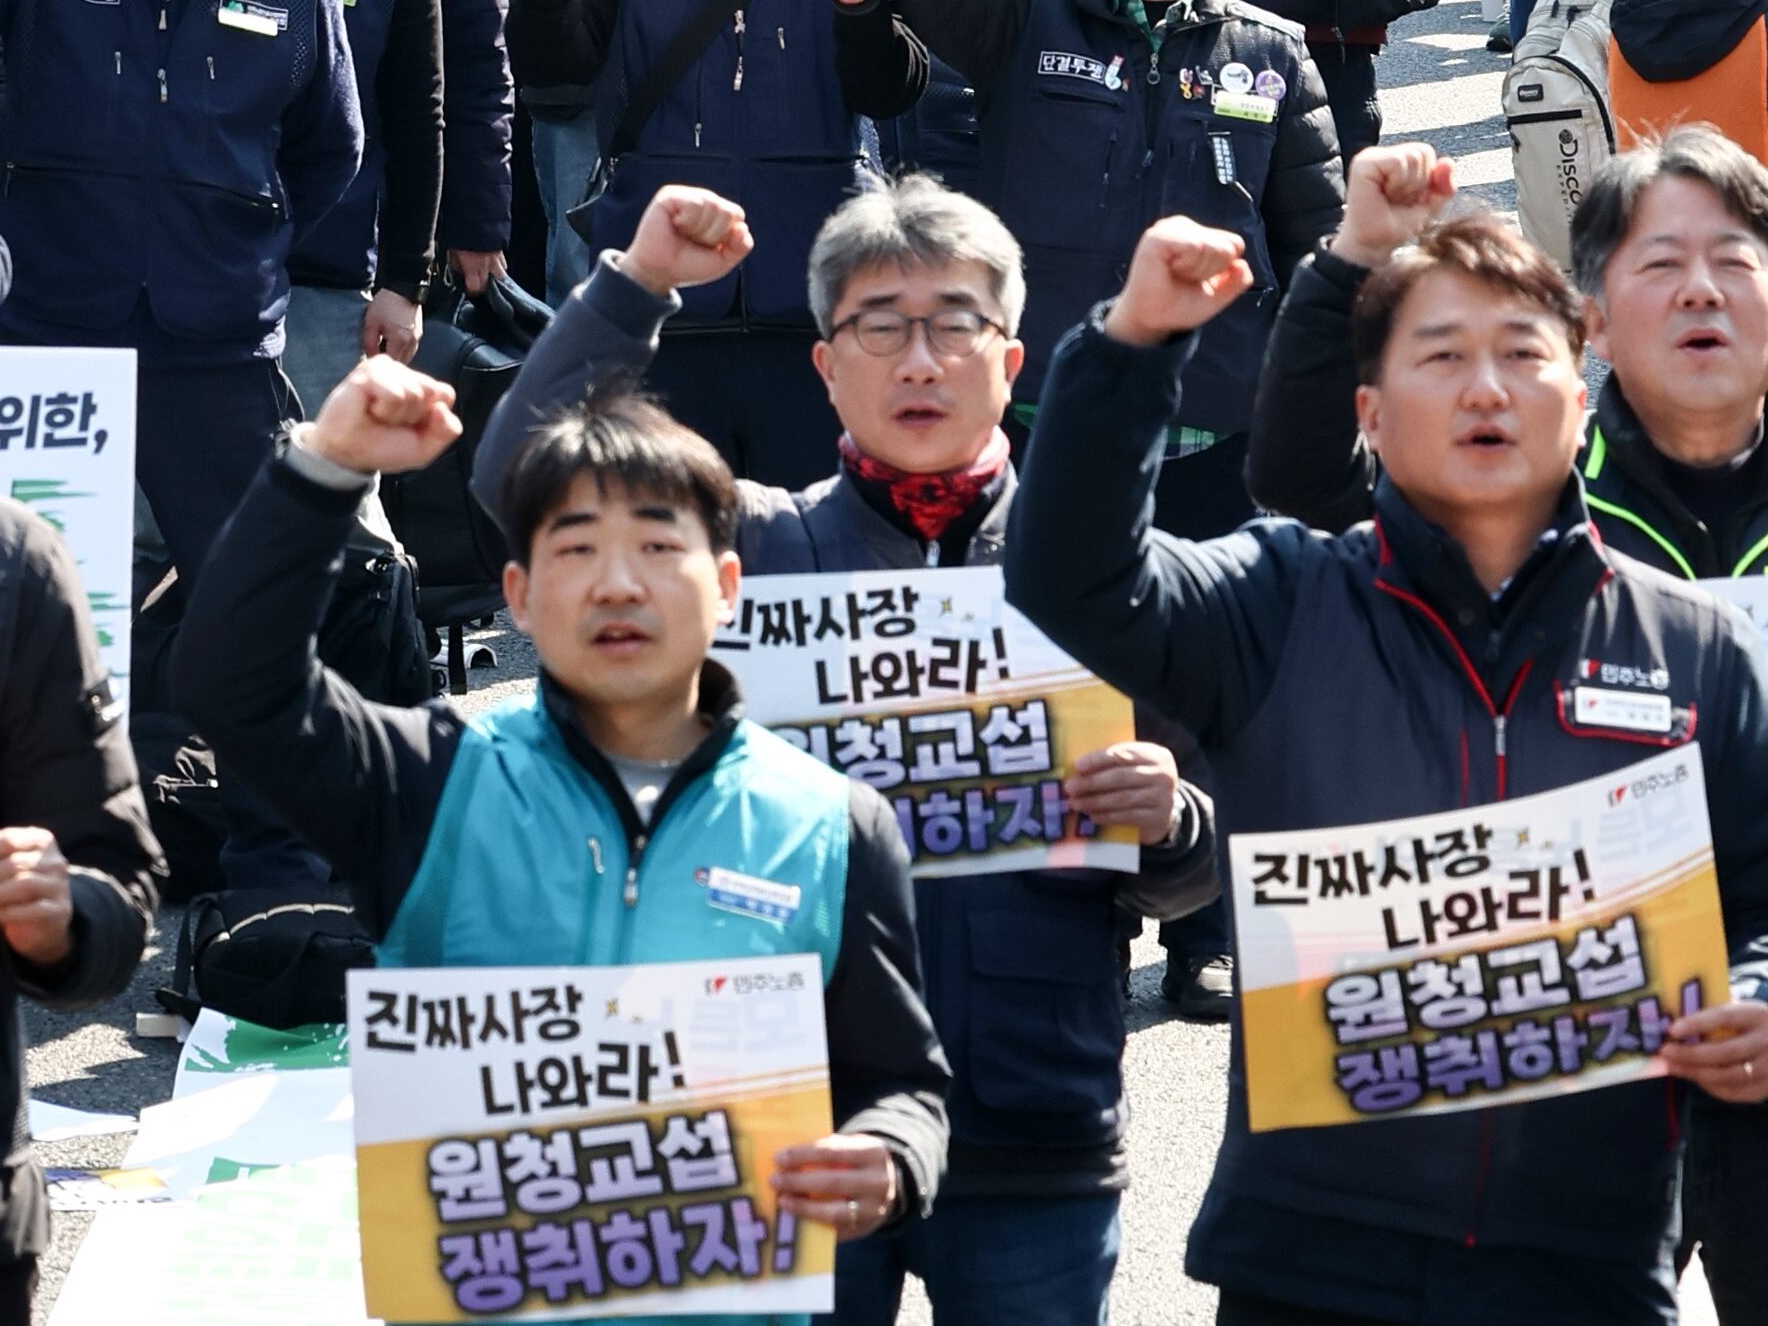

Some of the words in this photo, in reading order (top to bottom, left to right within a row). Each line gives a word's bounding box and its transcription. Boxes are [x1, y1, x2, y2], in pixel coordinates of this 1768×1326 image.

[1042, 54, 1105, 79] 단결투쟁
[815, 627, 1010, 705] 나와라!
[1252, 824, 1495, 906] 진짜사장
[1382, 847, 1597, 952] 나와라!
[365, 984, 583, 1053] 진짜사장
[1324, 914, 1648, 1045] 원청교섭
[480, 1032, 686, 1119] 나와라!
[1334, 978, 1704, 1114] 쟁취하자!
[428, 1111, 739, 1225] 원청교섭
[440, 1197, 801, 1314] 쟁취하자!
